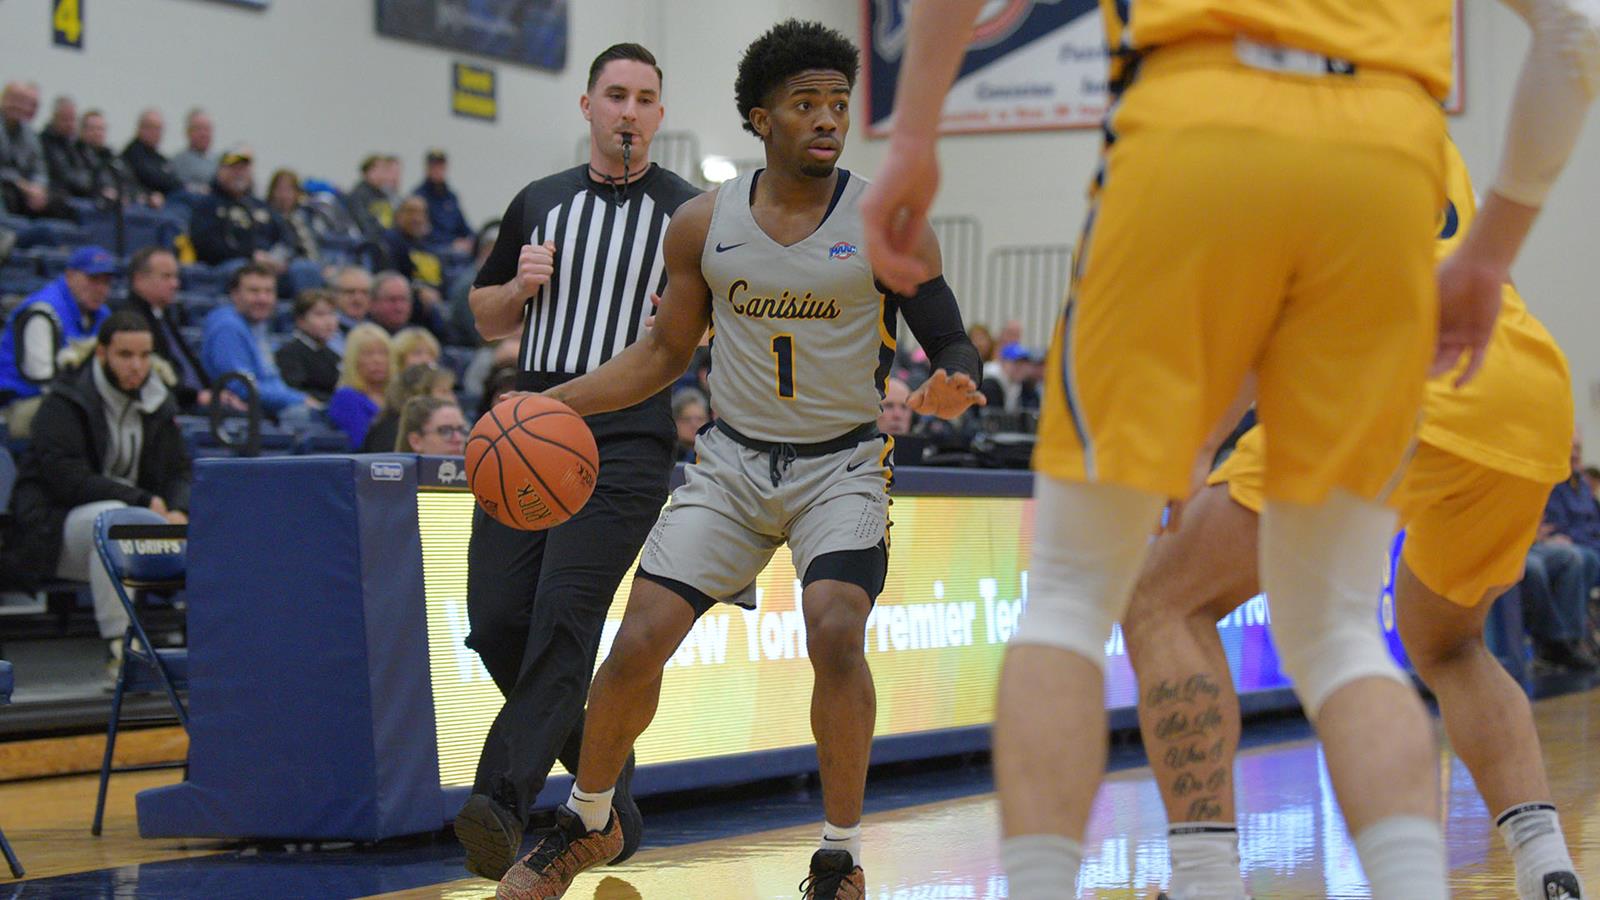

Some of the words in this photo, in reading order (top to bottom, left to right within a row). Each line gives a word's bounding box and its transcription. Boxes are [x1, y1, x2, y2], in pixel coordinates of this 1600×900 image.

[54, 0, 82, 43] 4
[829, 244, 858, 259] MAAC
[728, 279, 841, 320] Canisius
[771, 333, 796, 400] 1
[664, 613, 731, 668] ew
[864, 580, 977, 653] remier
